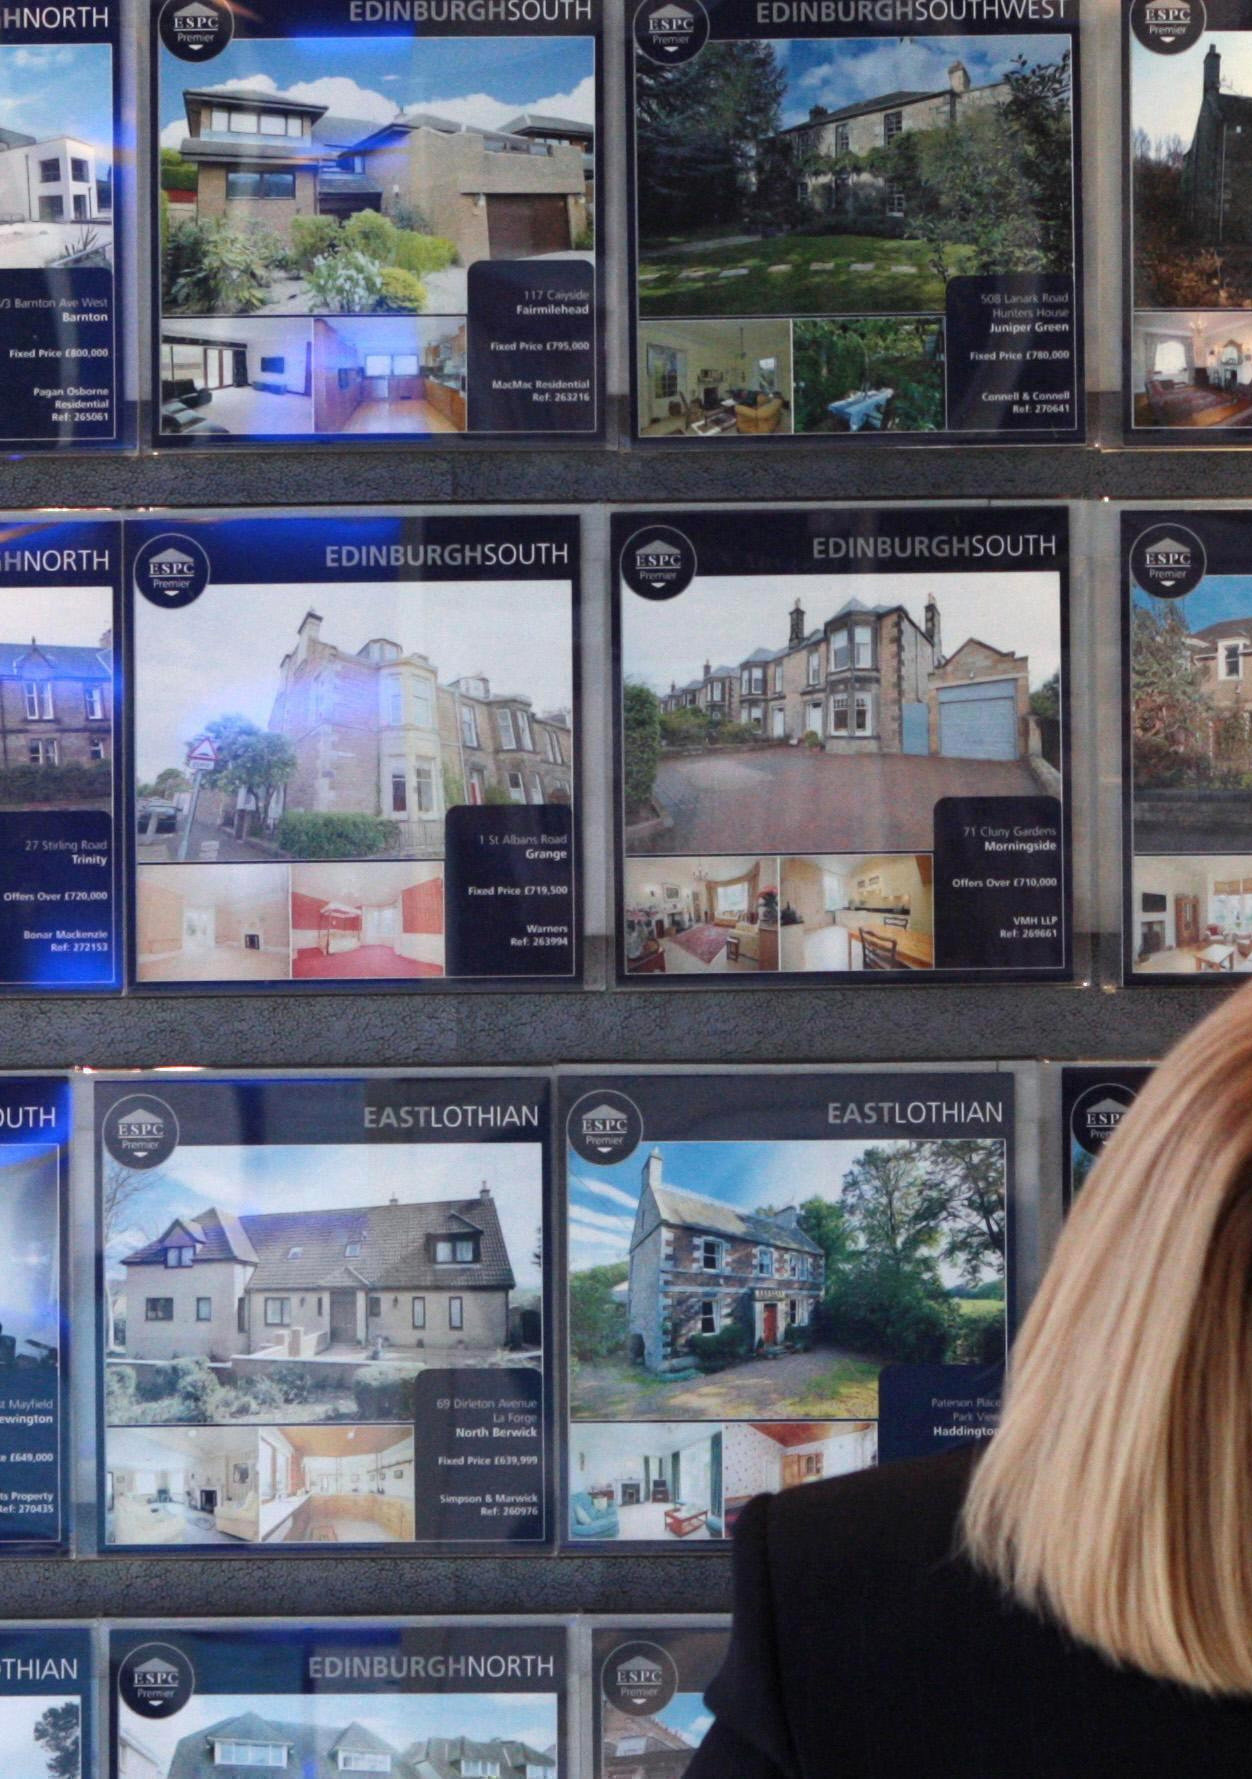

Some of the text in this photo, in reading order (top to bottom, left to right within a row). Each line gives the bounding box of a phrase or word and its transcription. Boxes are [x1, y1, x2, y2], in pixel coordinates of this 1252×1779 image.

[350, 0, 592, 21] EDINBURGHSOUTH
[756, 0, 1068, 23] EDINBURGHSOUTHWEST
[1145, 8, 1191, 22] ESPC
[174, 16, 219, 30] ESPC
[648, 17, 694, 32] ESPC
[1149, 24, 1187, 36] Premier
[177, 32, 215, 43] Premier
[652, 34, 691, 47] Premier
[524, 290, 542, 300] 117
[1042, 293, 1069, 303] Road
[15, 298, 108, 309] Barnton Ave West
[516, 304, 590, 315] Fairmilehead
[992, 307, 1070, 318] Hunters House
[62, 312, 108, 322] Barnton
[990, 322, 1069, 335] Juniper Green
[490, 341, 590, 352] Fixed Price £795,000
[9, 348, 109, 359] Fixed Price £800,000
[970, 351, 996, 361] Fixed
[999, 351, 1023, 360] Price
[492, 380, 590, 389] MacMac Residential
[33, 387, 109, 398] Pagan Osborne
[532, 392, 551, 402] Ref:
[55, 400, 109, 409] Residential
[51, 412, 72, 422] Ref:
[812, 535, 1057, 560] EDINBURGHSOUTH
[326, 543, 569, 568] EDINBURGHSOUTH
[636, 553, 682, 567] ESPC
[1145, 552, 1192, 566] ESPC
[149, 562, 195, 576] ESPC
[1149, 567, 1187, 581] Premier
[640, 570, 677, 582] Premier
[153, 578, 191, 590] Premier
[1013, 826, 1057, 837] Gardens
[502, 834, 538, 845] Albans
[541, 834, 568, 844] Road
[25, 841, 40, 851] 27
[81, 840, 108, 850] Road
[984, 841, 1057, 853] Morningside
[72, 854, 108, 867] Trinity
[525, 849, 568, 861] Grange
[952, 878, 1058, 889] Offers Over £710,000
[3, 892, 35, 901] Offers
[37, 892, 61, 901] Over
[468, 886, 495, 896] Fixed
[497, 886, 521, 896] Price
[1013, 916, 1058, 926] VMH LLP
[55, 930, 108, 939] Mackenzie
[526, 924, 568, 934] Warners
[1000, 929, 1019, 939] Ref:
[50, 942, 71, 952] Ref:
[510, 937, 530, 947] Ref:
[364, 1105, 539, 1128] EASTLOTHIAN
[828, 1101, 1003, 1125] EASTLOTHIAN
[118, 1122, 164, 1136] ESPC
[582, 1118, 628, 1132] ESPC
[121, 1138, 159, 1150] Premier
[586, 1134, 624, 1147] Premier
[498, 1398, 538, 1409] Avenue
[456, 1427, 538, 1438] North Berwick
[438, 1455, 465, 1466] Fixed
[467, 1456, 491, 1465] Price
[11, 1491, 54, 1502] Property
[440, 1493, 539, 1505] Simpson & Marwick
[480, 1506, 500, 1516] Ref:
[309, 1655, 554, 1680] EDINBURGHNORTH
[133, 1671, 179, 1685] ESPC
[616, 1670, 663, 1684] ESPC
[137, 1688, 175, 1700] Premier
[620, 1685, 659, 1698] Premier
